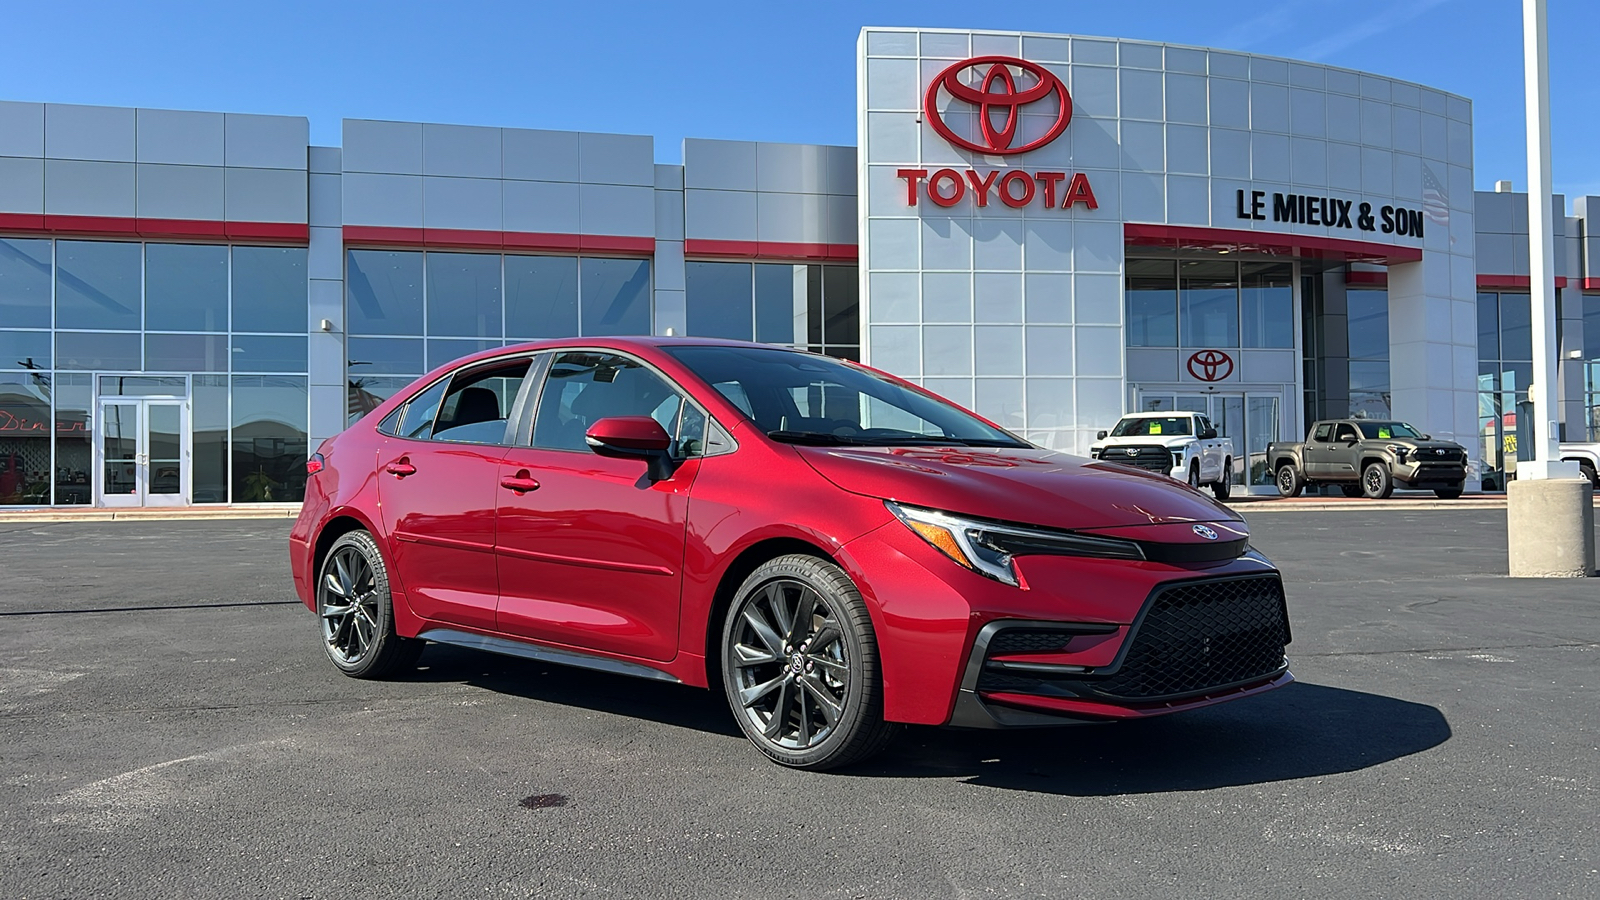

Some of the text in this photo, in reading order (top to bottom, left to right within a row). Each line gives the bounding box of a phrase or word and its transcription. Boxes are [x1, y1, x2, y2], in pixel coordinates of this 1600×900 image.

[897, 168, 1099, 209] TOYOTA
[1237, 189, 1424, 238] LE MIEUX & SON
